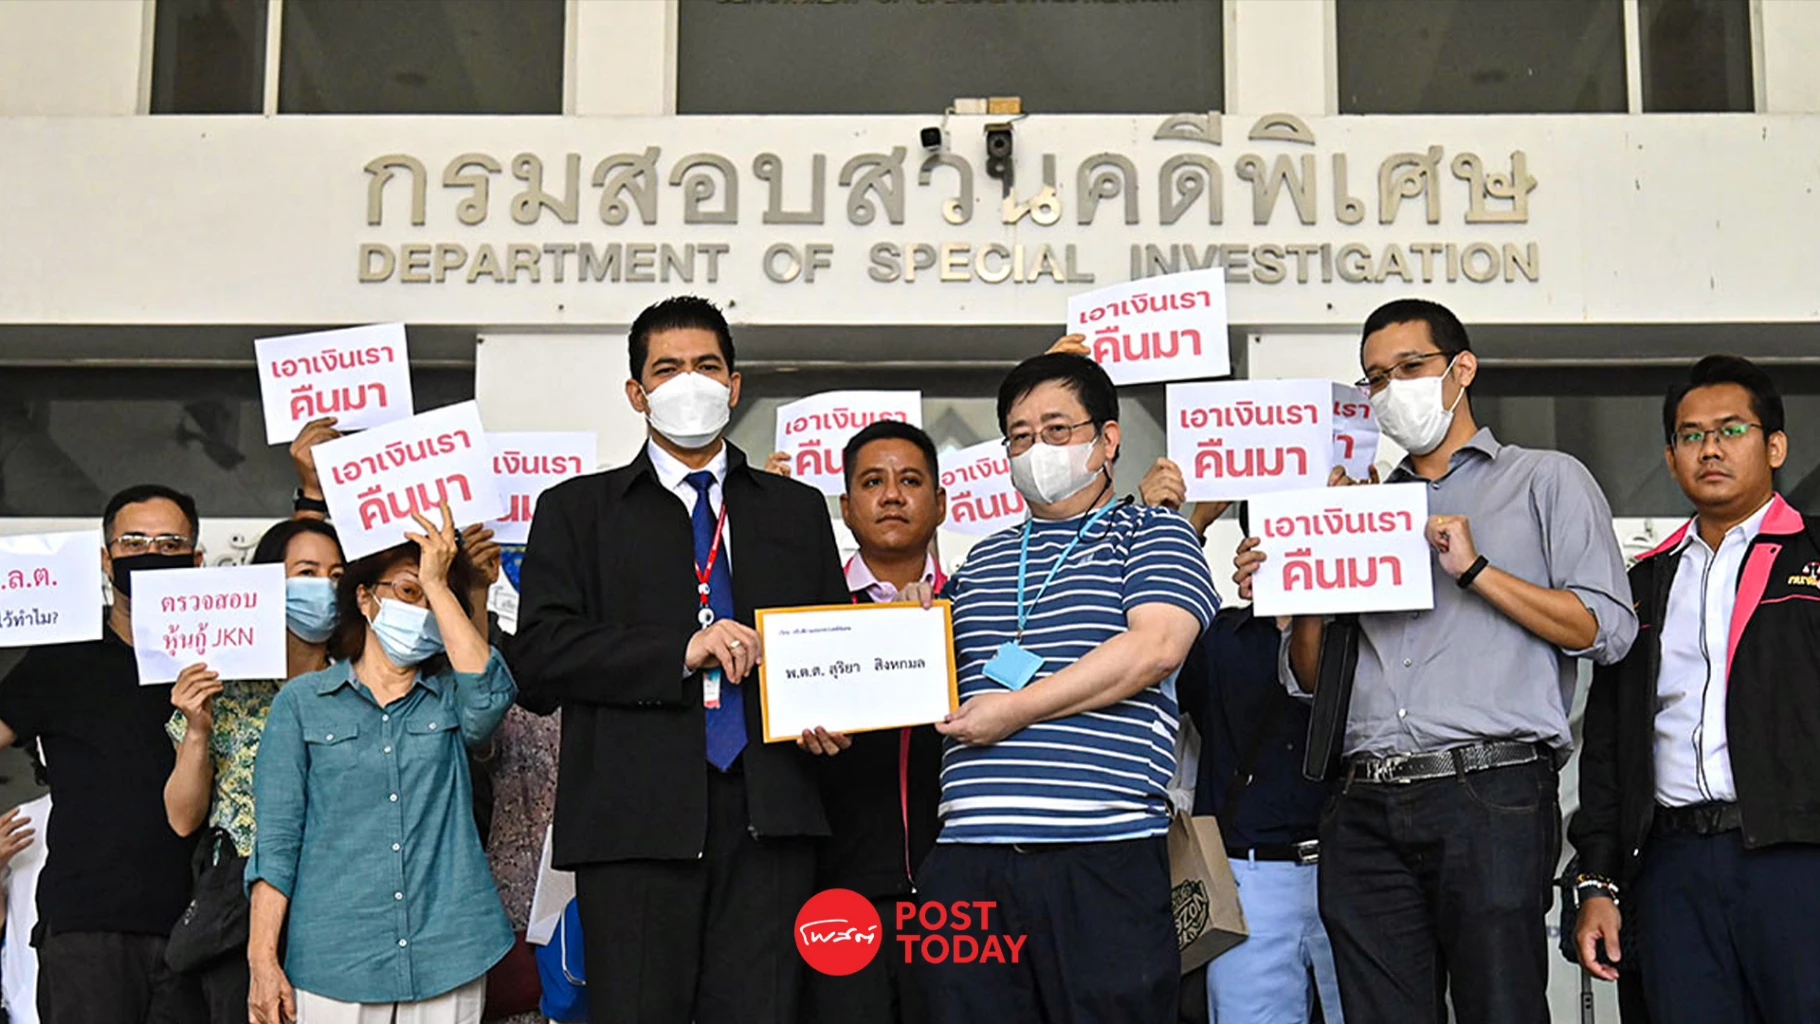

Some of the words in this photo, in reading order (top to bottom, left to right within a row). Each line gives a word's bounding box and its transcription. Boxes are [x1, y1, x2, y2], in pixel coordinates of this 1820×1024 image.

[364, 111, 1538, 226] กรมสอบสวนคดีพิเศษ
[359, 243, 730, 284] DEPARTMENT
[762, 243, 833, 284] OF
[868, 242, 1095, 284] SPECIAL
[1130, 242, 1539, 284] INVESTIGATION
[1079, 290, 1211, 324] เอาเงินเรา
[271, 345, 394, 378] เอาเงินเรา
[1093, 325, 1202, 364] คืนมา
[290, 382, 388, 421] คืนมา
[1180, 400, 1318, 429] เอาเงินเรา
[331, 429, 471, 485] เอาเงินเรา
[493, 451, 582, 474] เงินเรา
[1194, 438, 1307, 479] คืนมา
[358, 473, 472, 531] คืนมา
[951, 490, 1025, 523] คืนม
[1264, 508, 1412, 538] เอาเงินเรา
[0, 567, 58, 590] .ล.ต.
[1282, 547, 1402, 591] คืนมา
[161, 591, 258, 613] ตรวจสอบ
[162, 622, 208, 656] หุ้นกู้
[212, 627, 254, 648] JKN
